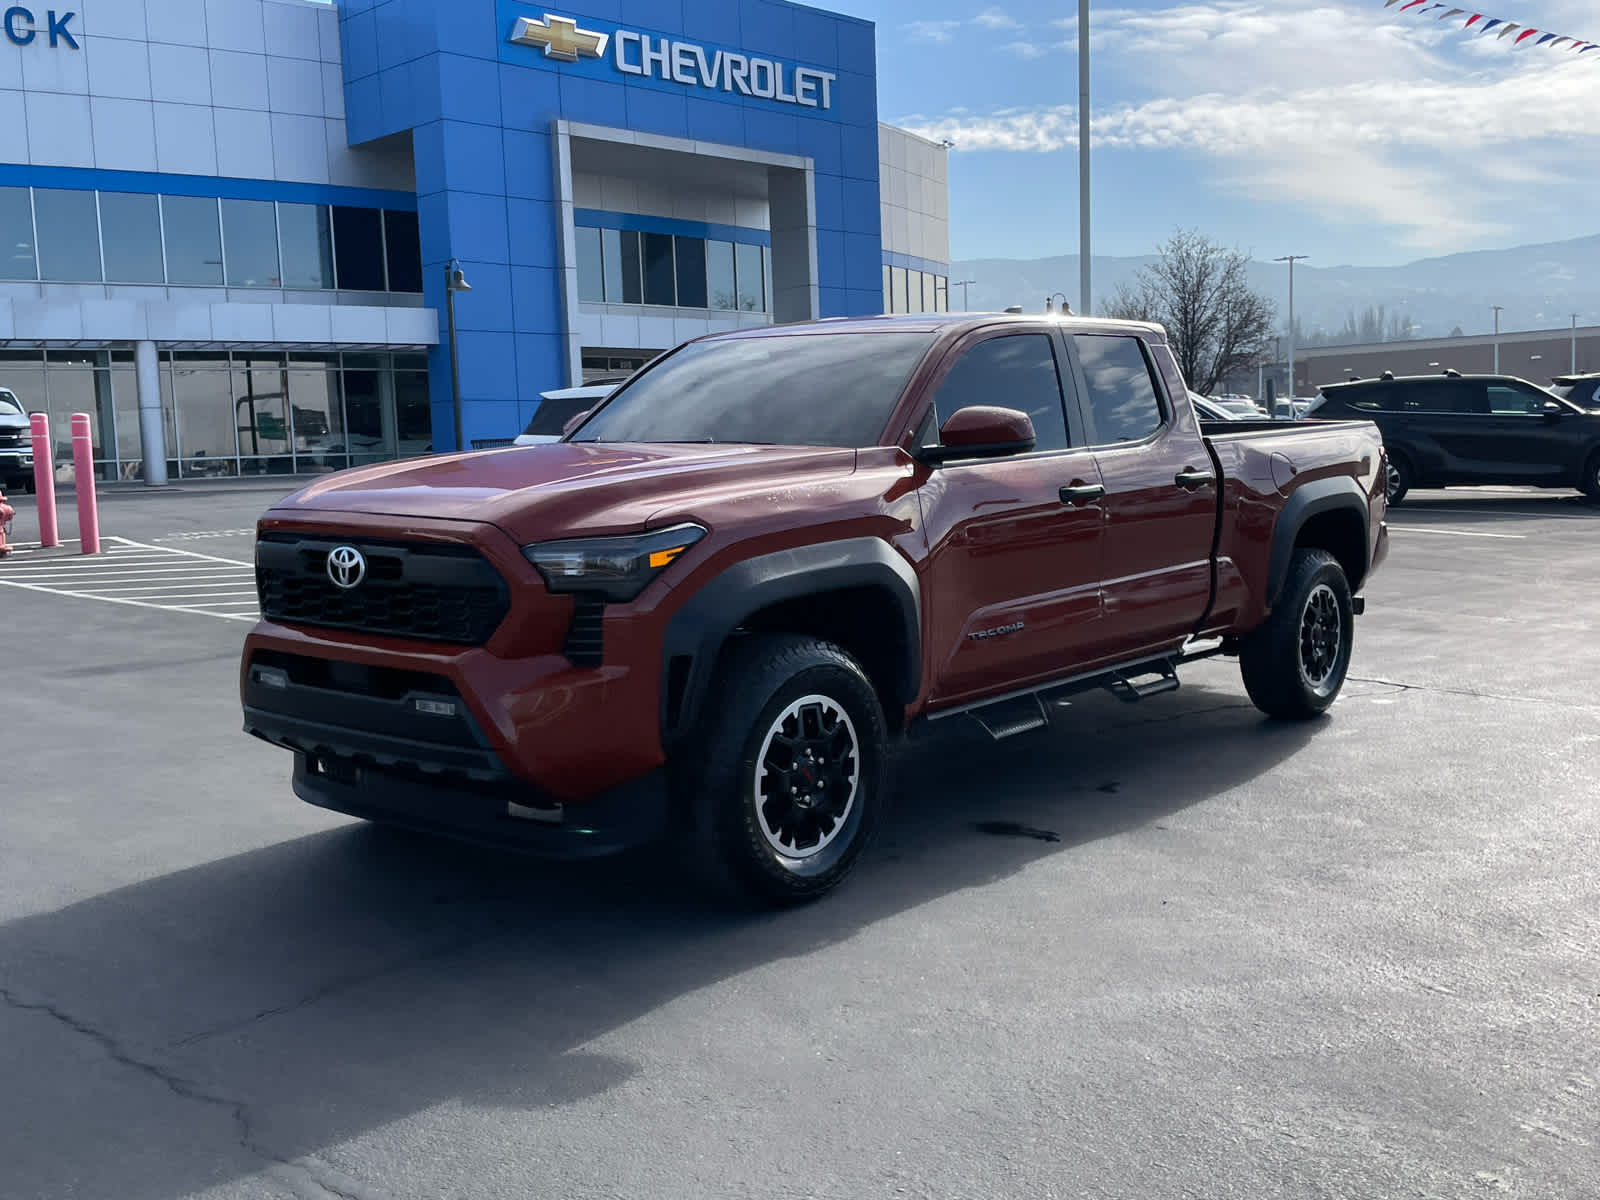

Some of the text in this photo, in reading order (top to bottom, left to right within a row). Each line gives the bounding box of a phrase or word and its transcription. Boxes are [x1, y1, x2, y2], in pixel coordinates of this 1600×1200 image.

[4, 6, 80, 50] CK
[615, 29, 836, 109] CHEVROLET
[967, 621, 1025, 640] TACOMA
